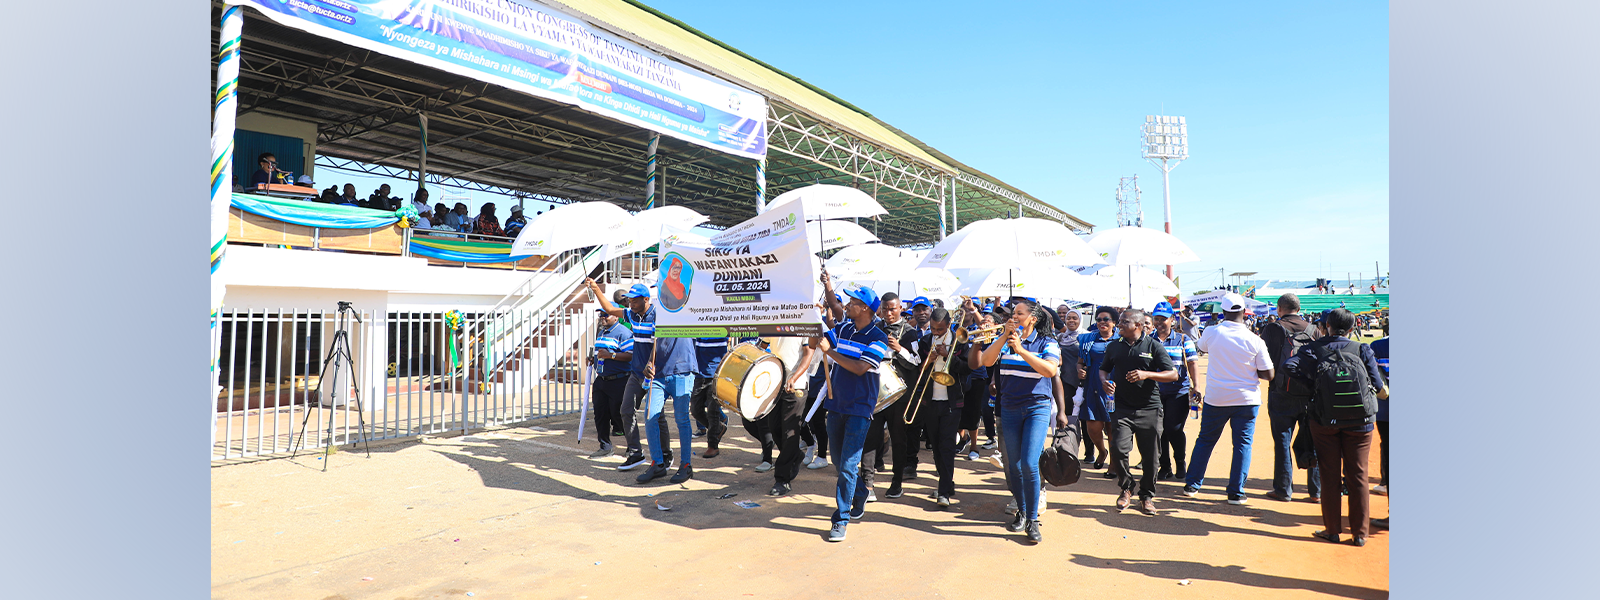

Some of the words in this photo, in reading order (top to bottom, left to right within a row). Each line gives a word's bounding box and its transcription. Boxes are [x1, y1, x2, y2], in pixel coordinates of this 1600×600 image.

[445, 16, 475, 35] KWENYE
[475, 28, 525, 51] MAADHIMISHO
[525, 44, 535, 54] YA
[551, 53, 560, 62] YA
[497, 0, 533, 18] UNION
[536, 10, 588, 40] CONGRESS
[590, 32, 602, 46] OF
[603, 38, 644, 64] TANZANIA
[513, 17, 528, 32] LA
[531, 23, 567, 44] VYAMA
[570, 35, 587, 52] VYA
[645, 69, 682, 91] TANZANIA
[436, 44, 449, 55] ya
[450, 47, 500, 70] Mishahara
[500, 63, 511, 74] ni
[511, 65, 540, 83] Msingi
[540, 76, 552, 86] wa
[594, 93, 604, 102] na
[603, 94, 623, 109] Kinga
[772, 216, 790, 232] TMDA
[693, 253, 779, 271] WAFANYAKAZI
[1033, 250, 1057, 258] TMDA
[713, 268, 763, 282] DUNIANI
[715, 283, 729, 292] 01.
[731, 282, 745, 291] 05.
[746, 281, 769, 291] 2024
